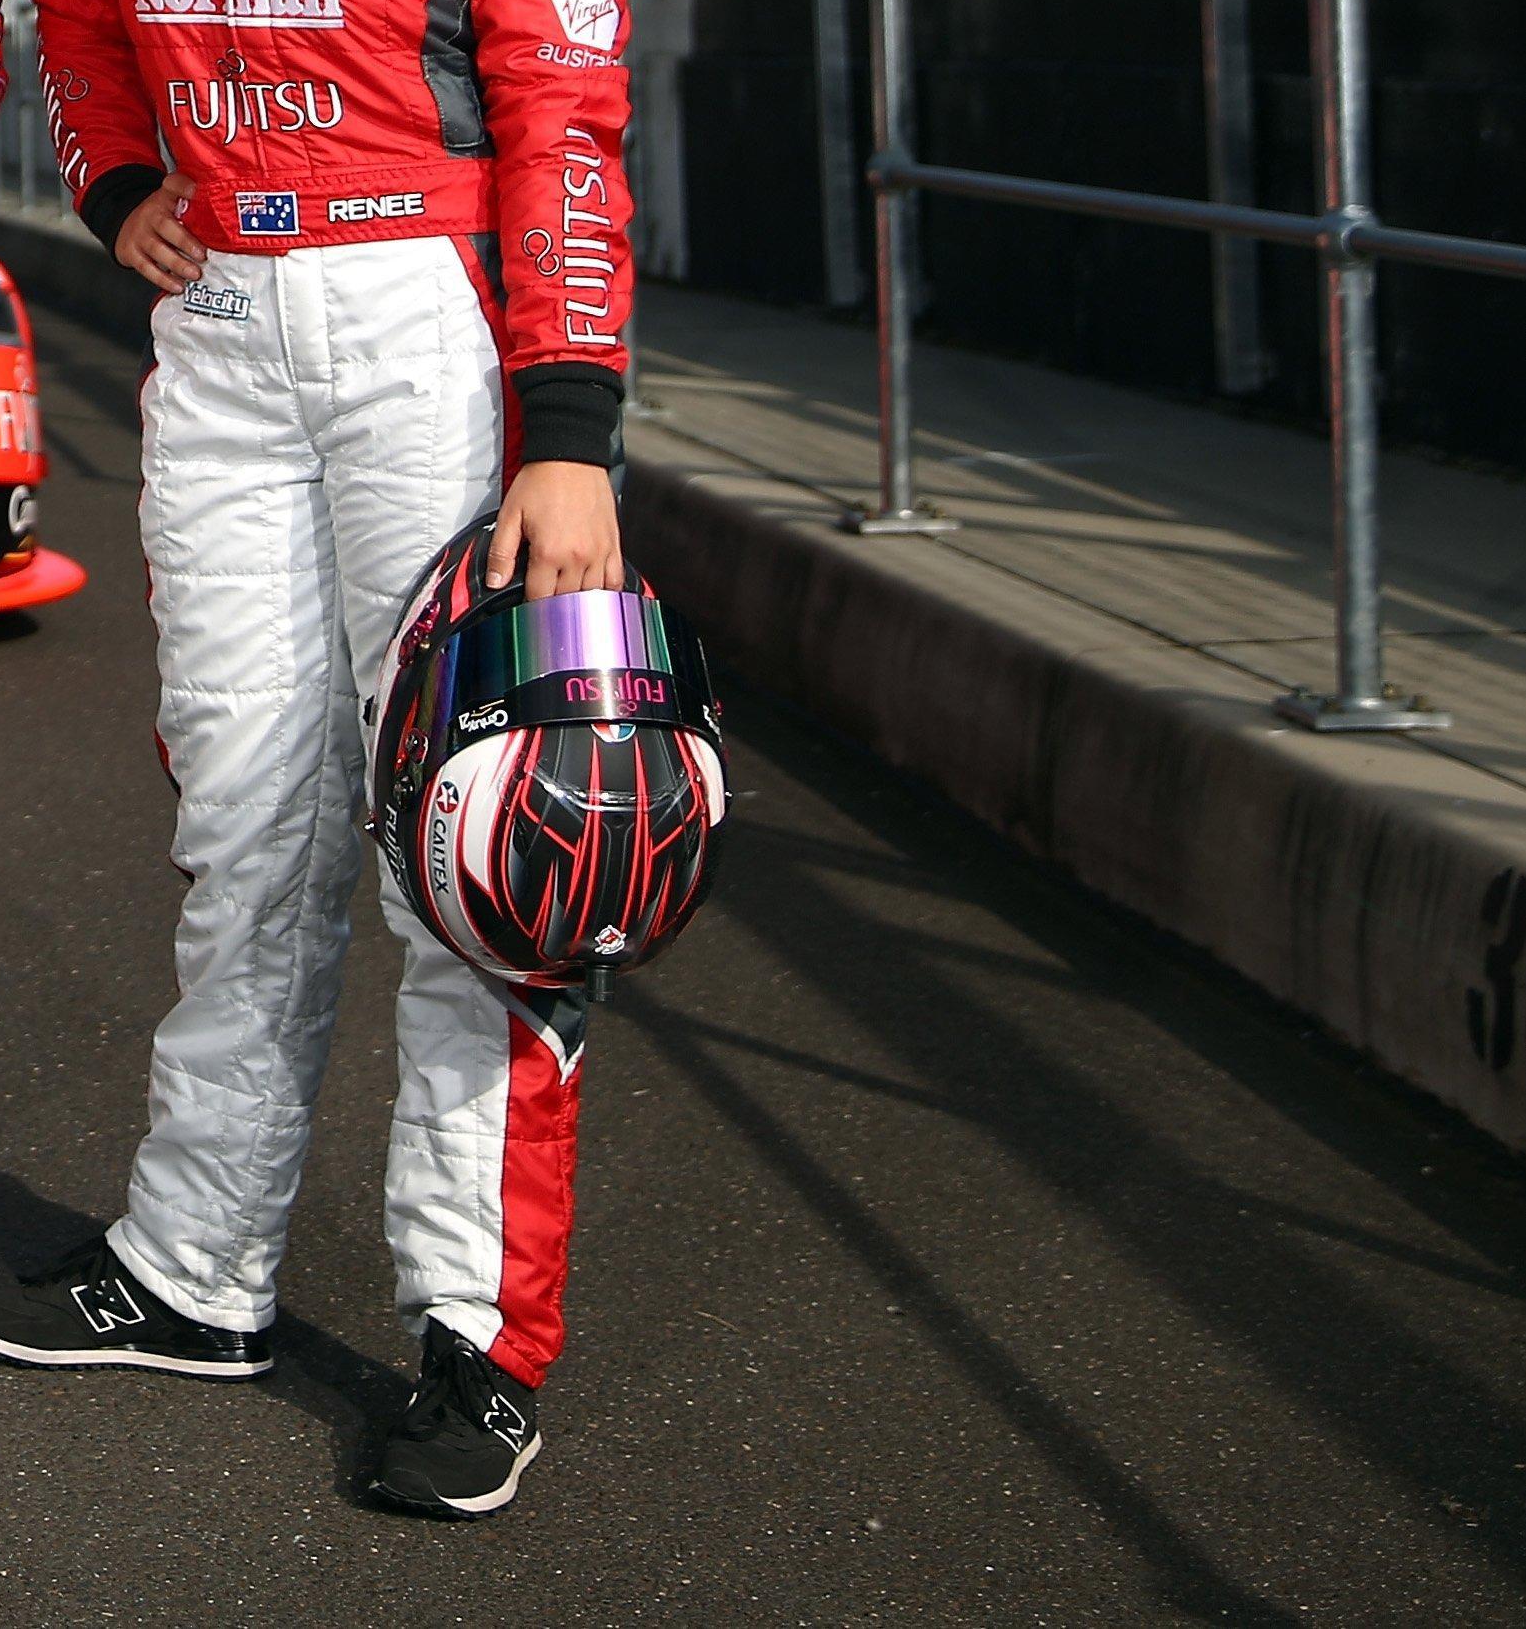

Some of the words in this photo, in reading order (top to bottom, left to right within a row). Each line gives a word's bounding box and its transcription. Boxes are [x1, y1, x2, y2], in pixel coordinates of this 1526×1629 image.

[167, 80, 343, 145] FUJITSU
[328, 192, 425, 223] RENEE
[563, 126, 618, 346] FUJITSU
[434, 818, 449, 894] CALTEX
